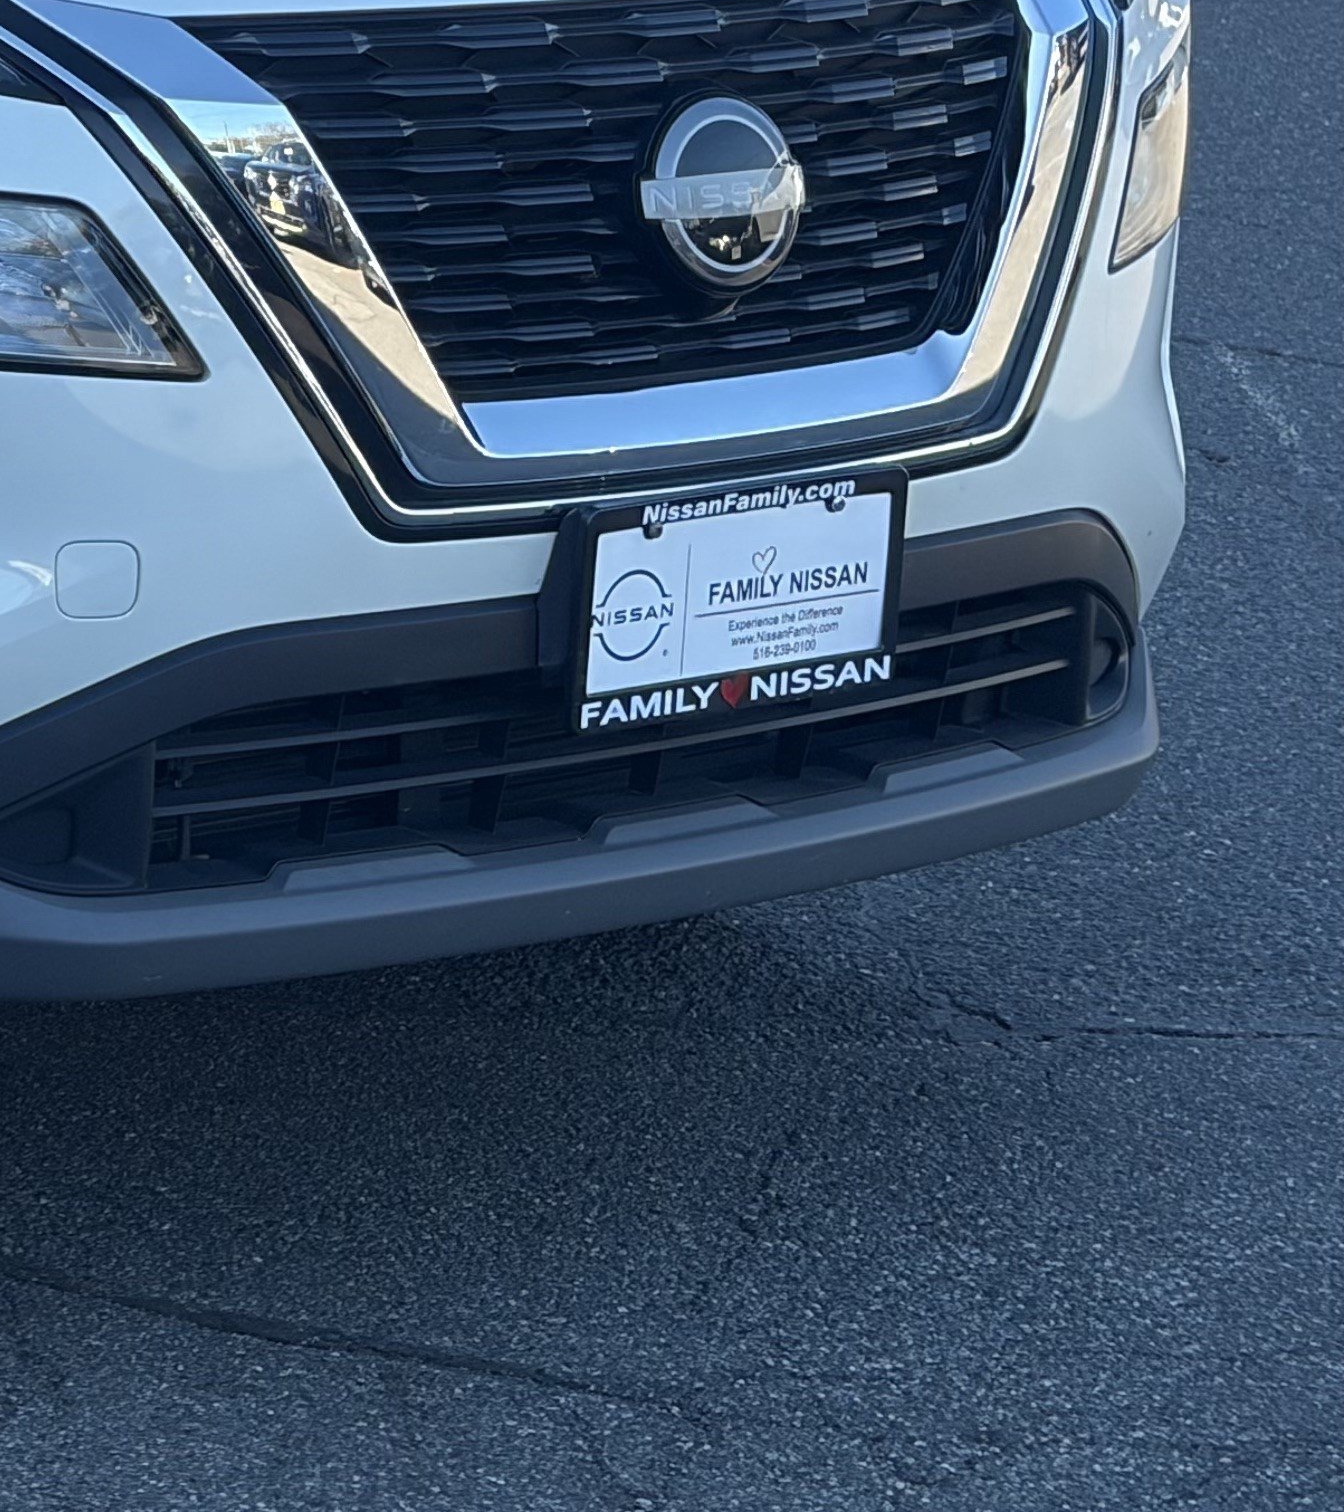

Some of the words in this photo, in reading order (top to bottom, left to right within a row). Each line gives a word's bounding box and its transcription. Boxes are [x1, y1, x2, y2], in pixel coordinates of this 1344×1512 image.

[642, 479, 856, 526] NissanFamily.com
[708, 574, 784, 606] FAMILY
[789, 562, 869, 595] NISSAN
[592, 602, 675, 627] NISSAN
[728, 615, 779, 632] Experience
[781, 612, 797, 624] the
[798, 605, 844, 621] Difference
[731, 621, 840, 647] www.NissanFamily.com
[579, 680, 722, 730] FAMILY
[749, 654, 892, 702] NISSAN
